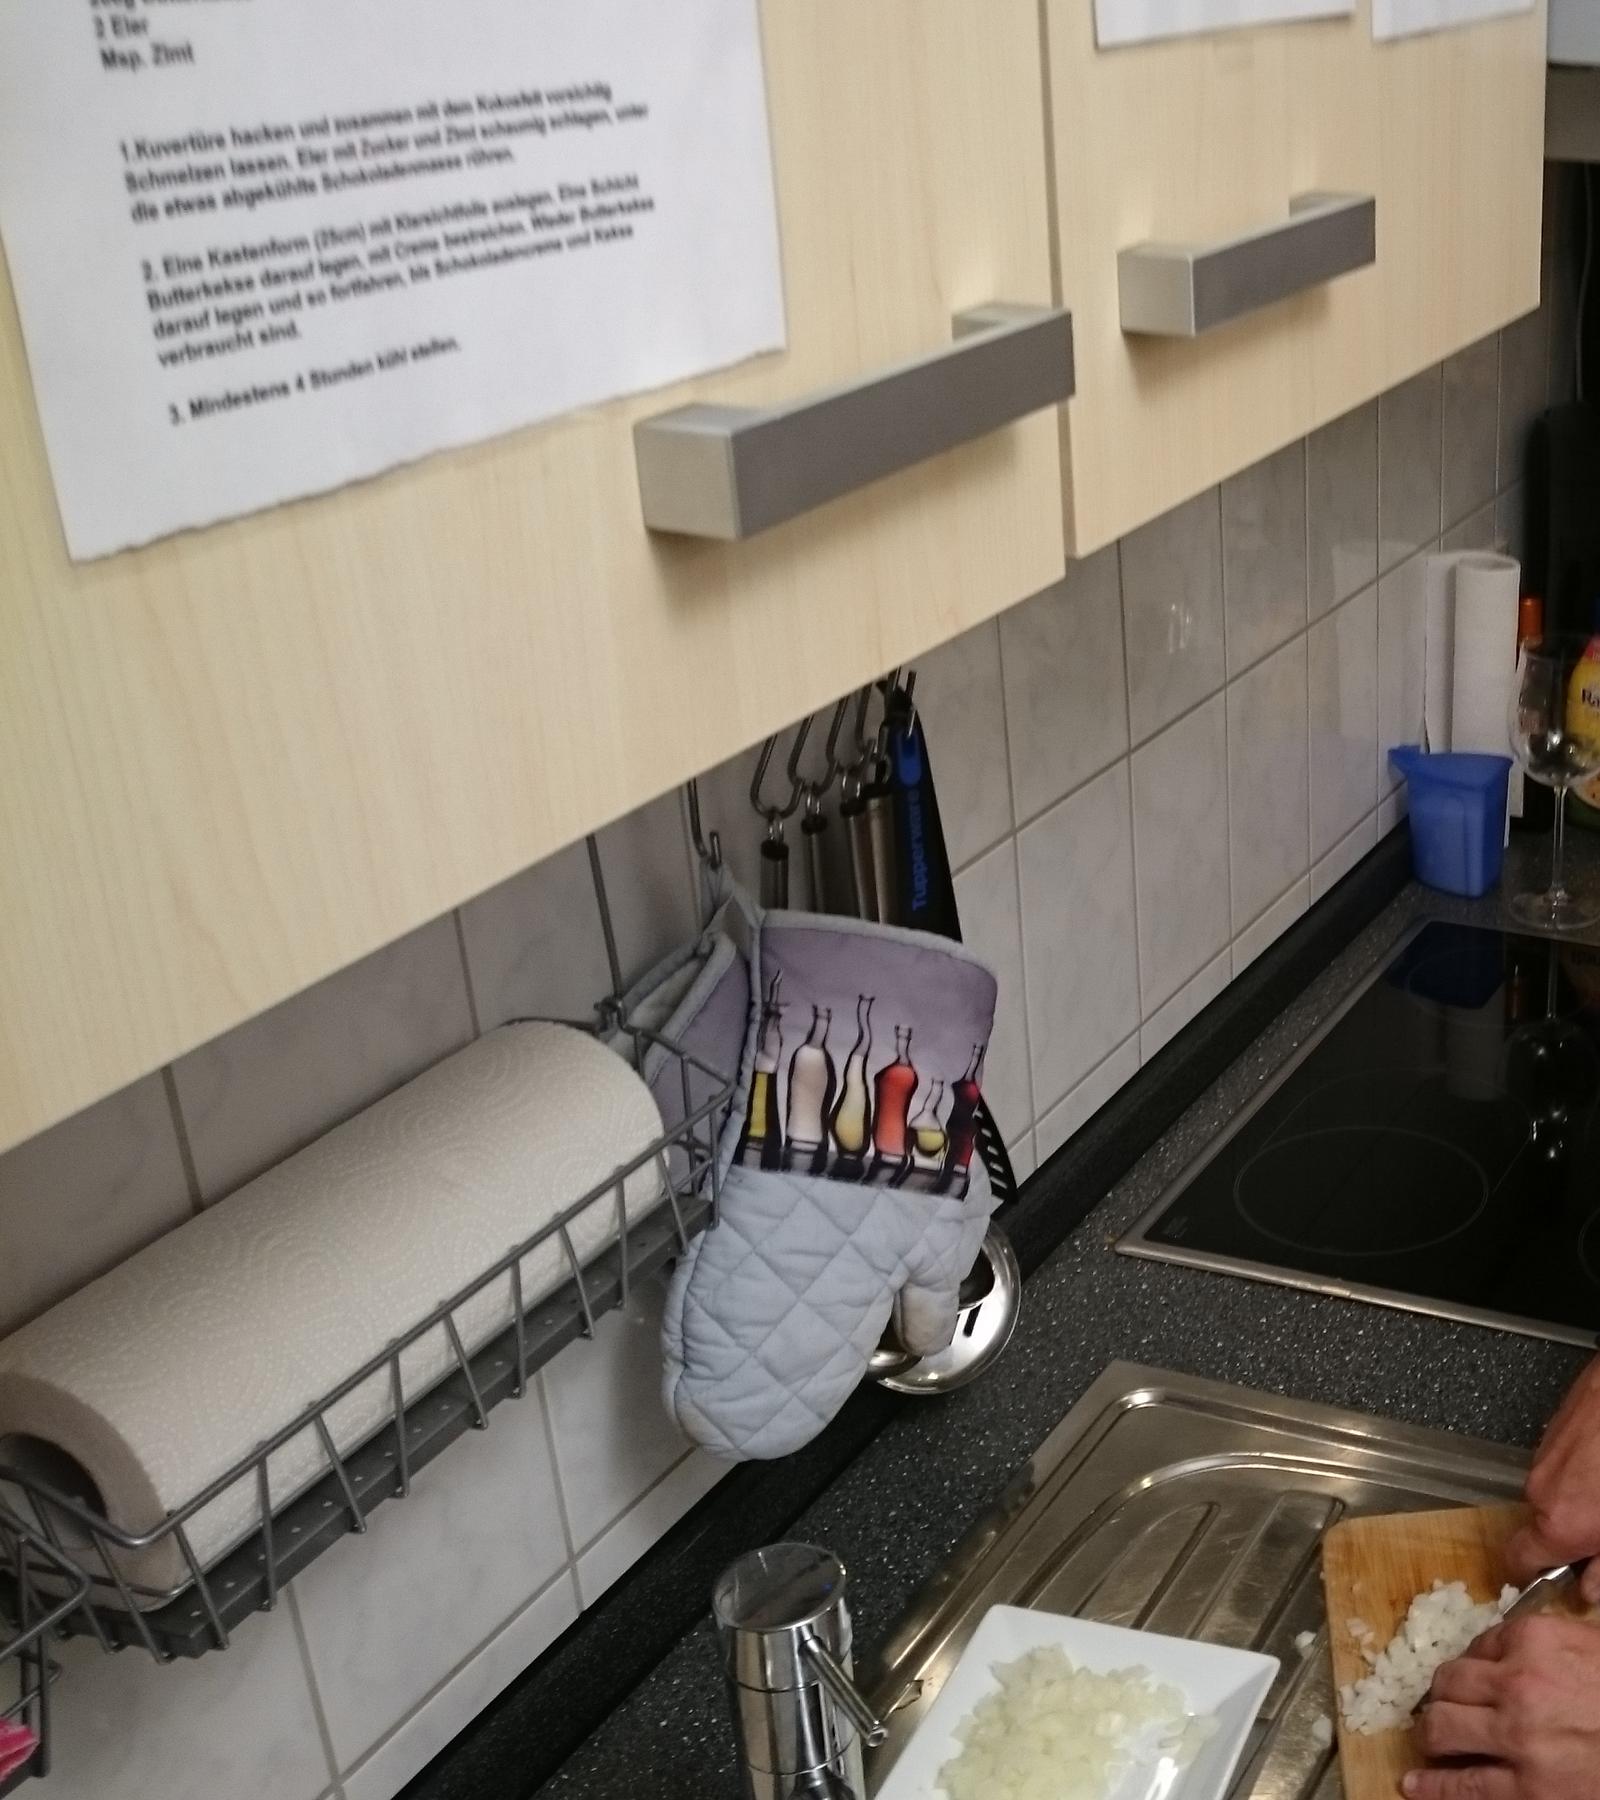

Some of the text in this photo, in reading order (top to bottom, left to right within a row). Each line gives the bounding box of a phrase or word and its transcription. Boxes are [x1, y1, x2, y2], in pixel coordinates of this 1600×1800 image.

[110, 14, 148, 38] Eier
[151, 40, 195, 66] Zimt
[125, 164, 225, 193] Schmelzen
[296, 148, 327, 168] Eier
[333, 142, 357, 161] mit
[361, 136, 408, 158] Zucker
[414, 129, 441, 149] und
[445, 125, 477, 144] Zimt
[616, 104, 648, 121] unter
[230, 125, 294, 146] hacken
[299, 116, 330, 139] und
[334, 109, 412, 134] zusammen
[416, 102, 439, 120] mit
[443, 101, 473, 117] dem
[477, 91, 542, 112] Kokosfett
[546, 82, 612, 104] vorsichtig
[131, 201, 159, 223] die
[164, 195, 216, 217] etwas
[222, 178, 317, 209] abgekühlte
[162, 256, 203, 278] Eine
[208, 238, 309, 268] Kastenform
[369, 218, 392, 237] mit
[558, 184, 587, 202] Eine
[147, 277, 254, 311] Butterkekse
[260, 260, 314, 287] darauf
[368, 245, 391, 264] mit
[394, 238, 440, 259] Creme
[531, 211, 575, 230] Wieder
[579, 198, 654, 223] Butterkekse
[154, 310, 209, 339] darauf
[214, 303, 263, 328] legen
[269, 291, 302, 315] und
[306, 290, 326, 307] so
[409, 264, 430, 283] bis
[566, 230, 591, 249] und
[159, 329, 253, 367] verbraucht
[189, 383, 290, 418] Mindestens
[296, 375, 305, 391] 4
[309, 361, 374, 389] Stunden
[376, 348, 407, 370] kühl
[909, 789, 928, 910] Tupperware
